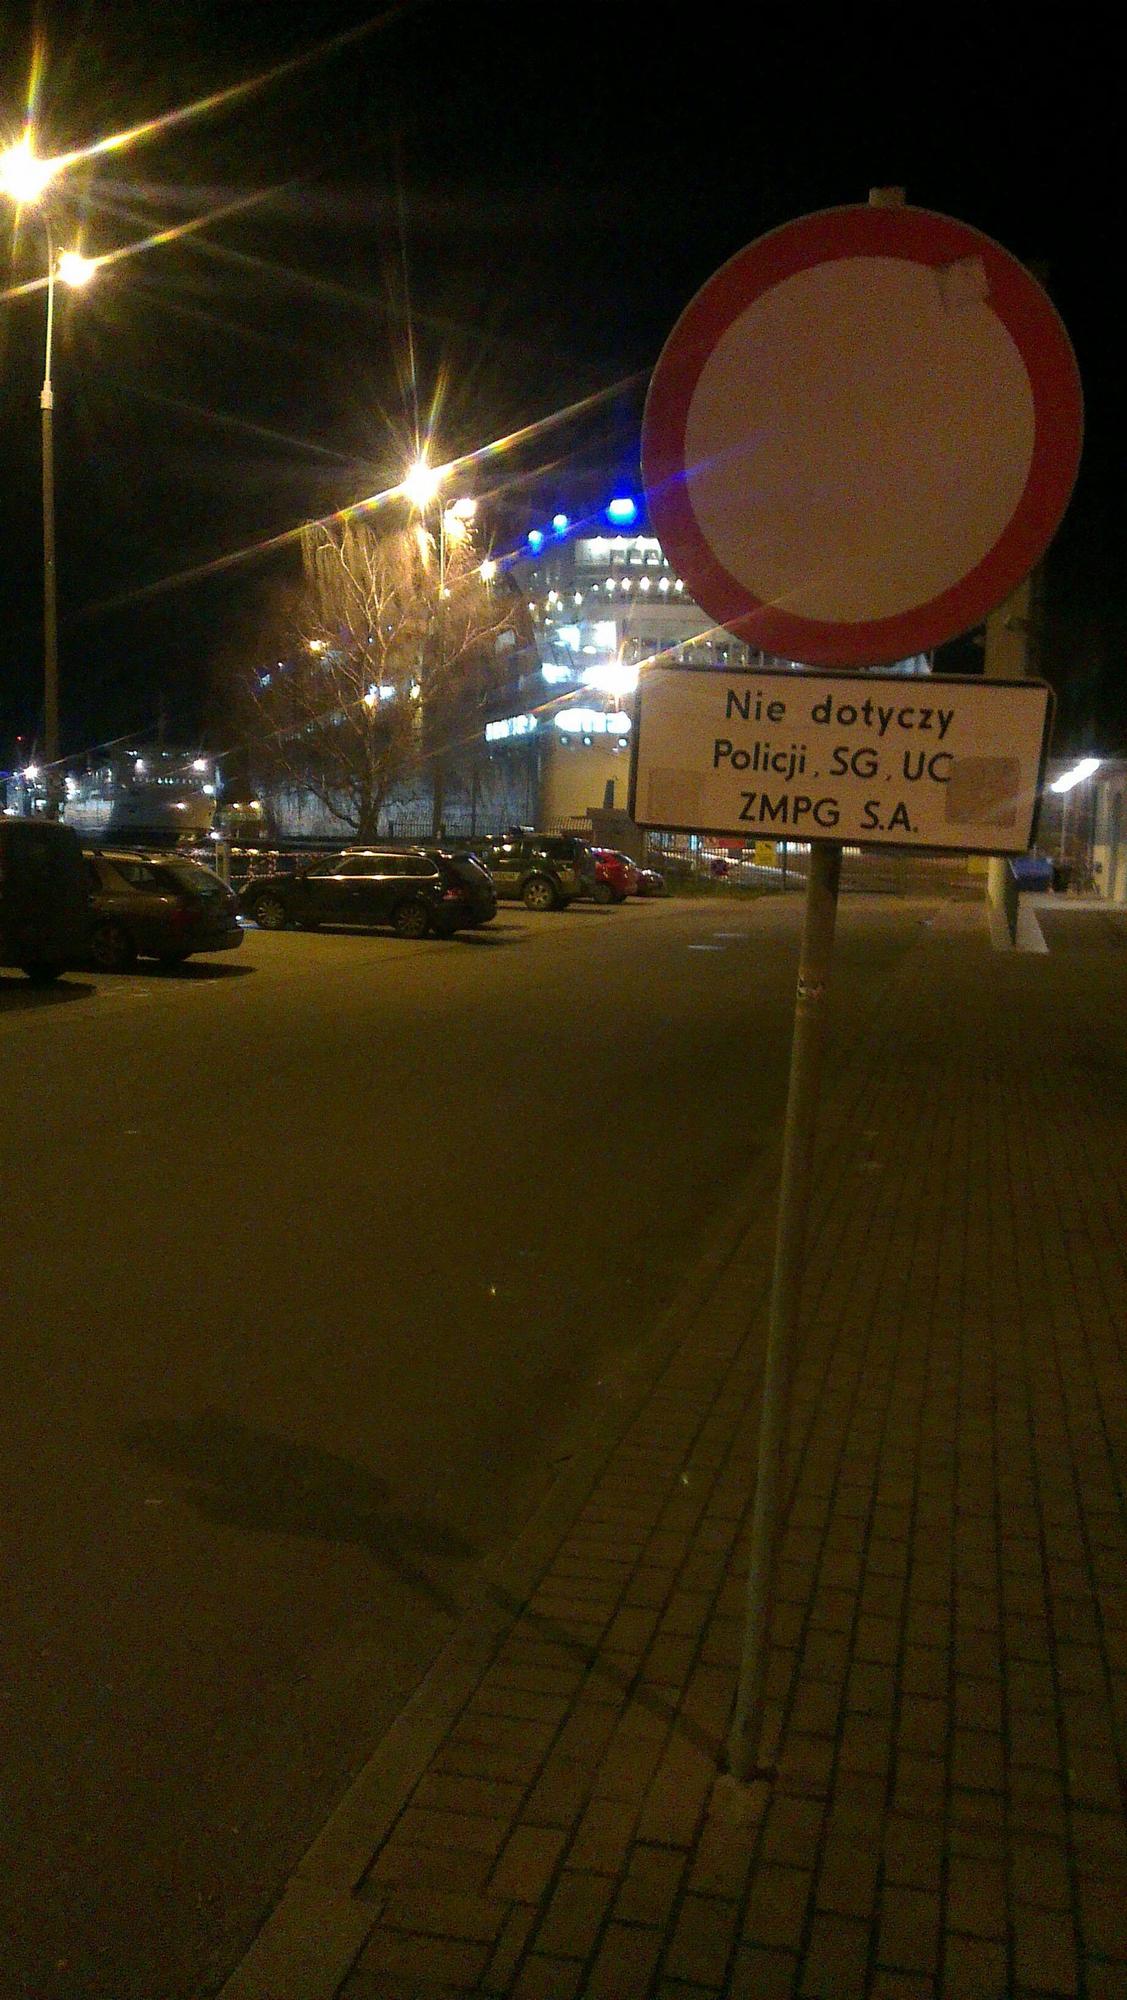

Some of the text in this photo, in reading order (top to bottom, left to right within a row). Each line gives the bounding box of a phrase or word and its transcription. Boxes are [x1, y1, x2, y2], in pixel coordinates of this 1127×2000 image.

[725, 689, 954, 738] Nie dotyczy
[903, 751, 954, 783] UC
[739, 792, 919, 832] ZMPG S.A.
